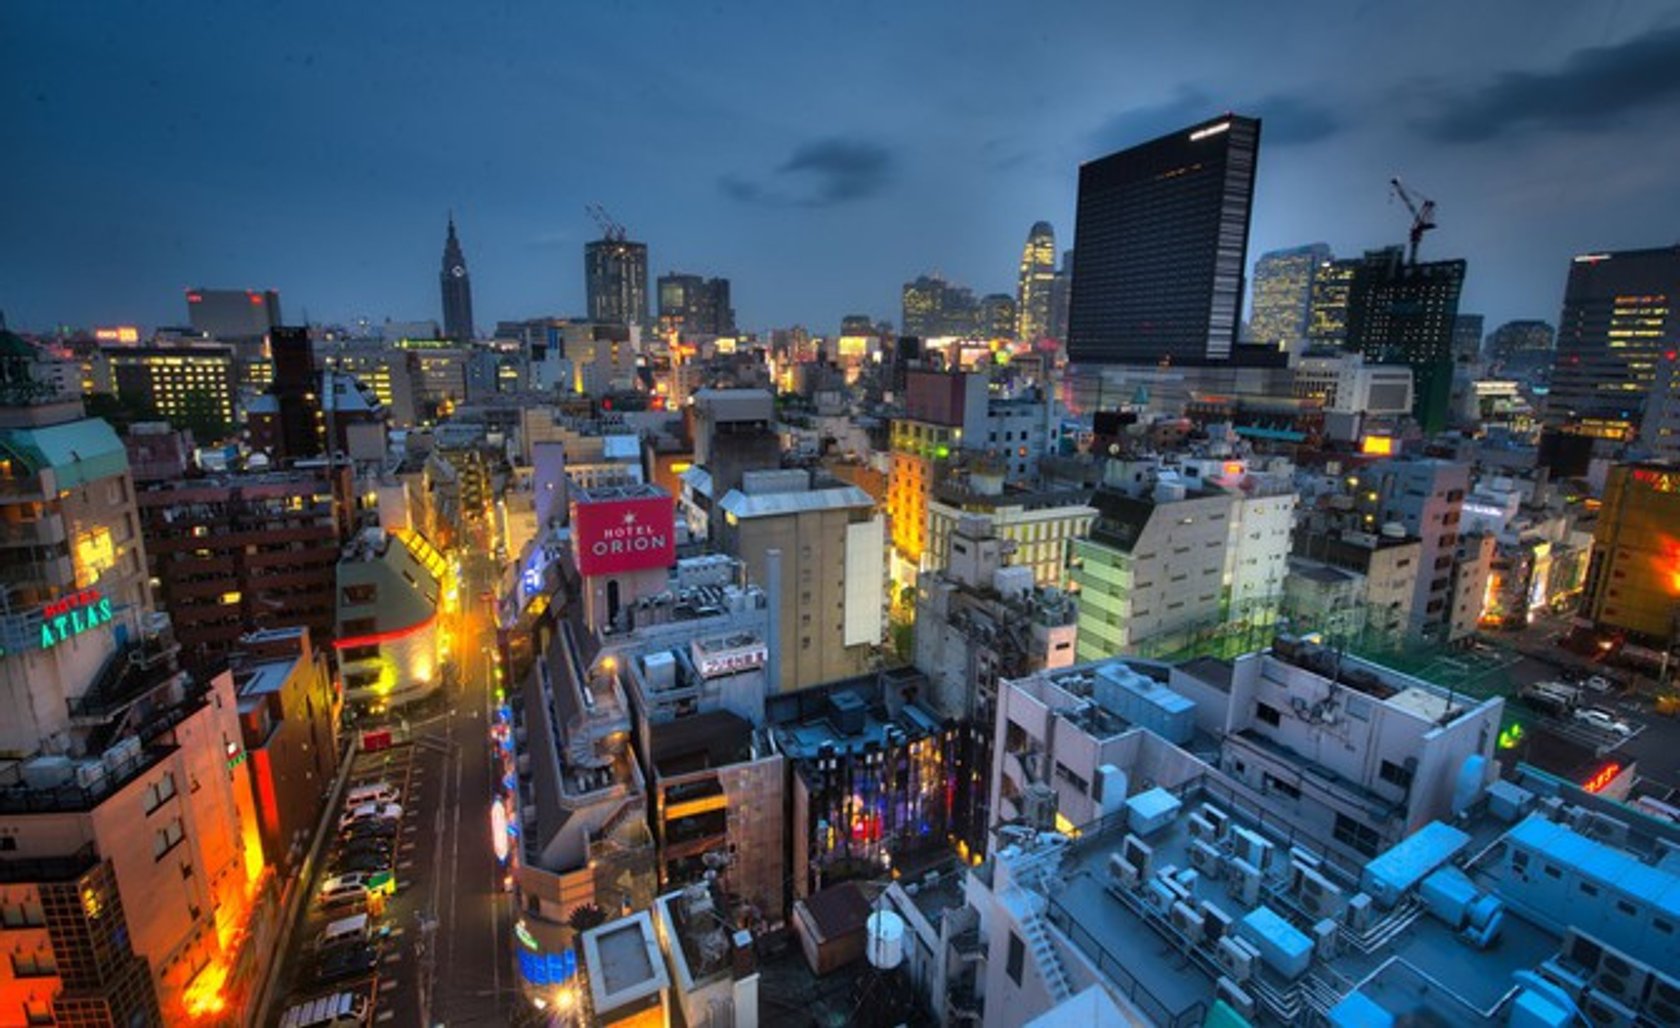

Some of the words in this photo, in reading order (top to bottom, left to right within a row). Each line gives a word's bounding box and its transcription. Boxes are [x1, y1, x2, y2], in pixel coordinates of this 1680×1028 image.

[604, 525, 653, 538] HOTEL
[592, 534, 665, 555] ORION
[41, 596, 112, 648] ATLAS
